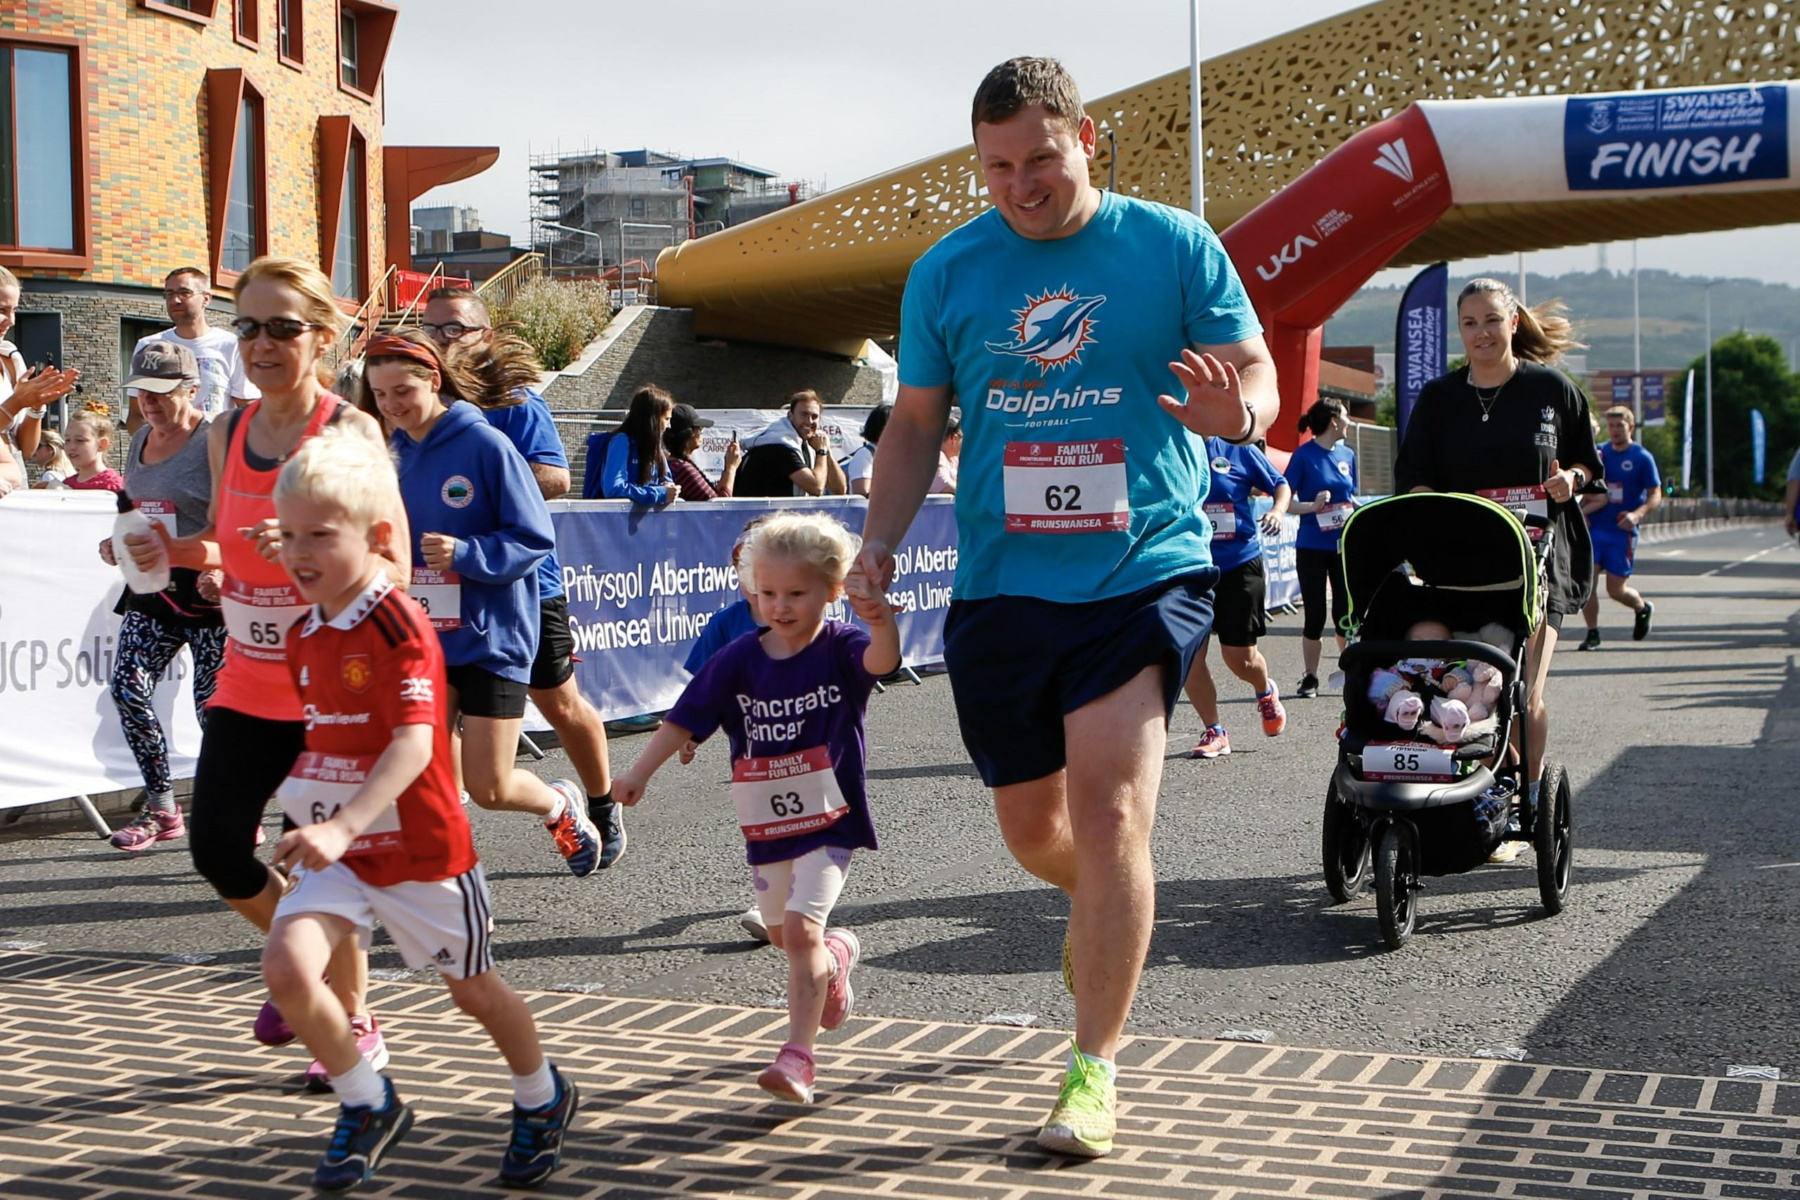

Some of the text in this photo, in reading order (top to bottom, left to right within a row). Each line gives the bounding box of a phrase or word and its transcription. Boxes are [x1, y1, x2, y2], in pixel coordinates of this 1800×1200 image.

[1664, 91, 1764, 110] SWANSEA
[1662, 105, 1765, 122] Half Marathon
[1590, 132, 1763, 180] FINISH
[1316, 208, 1338, 226] UNITED
[1320, 211, 1346, 232] KINGDOM
[1324, 213, 1354, 237] ATHLETICS
[1256, 234, 1319, 281] UKA
[1422, 306, 1435, 362] Marathon
[1408, 307, 1422, 389] SWANSEA
[989, 378, 1047, 390] MIAMI
[985, 385, 1123, 418] Dolphins
[1024, 418, 1070, 428] FOOTBALL
[703, 445, 727, 453] CARRE
[1057, 443, 1099, 456] FAMILY
[1053, 455, 1076, 466] FUN
[1078, 453, 1103, 465] RUN
[1045, 484, 1082, 512] 62
[1507, 487, 1532, 496] FAMILY
[1520, 493, 1535, 501] RUN
[1030, 518, 1102, 529] #RUNSWANSEA
[1211, 520, 1218, 532] 9
[1331, 514, 1344, 525] 56
[914, 545, 958, 574] Aberta
[413, 576, 445, 584] FUN RUN
[414, 569, 441, 577] FAMILY
[253, 586, 291, 597] FAMILY
[563, 561, 740, 610] Prifysgol Abertawe
[252, 595, 272, 606] FUN
[272, 595, 297, 606] RUN
[885, 581, 954, 615] nsea Unive
[249, 621, 280, 645] 65
[568, 602, 725, 654] Swansea Univer
[56, 636, 188, 689] Solirs
[744, 715, 806, 741] Cancer
[323, 756, 360, 770] FAMILY
[768, 754, 804, 770] FAMILY
[768, 767, 789, 779] FUN
[789, 762, 812, 776] RUN
[1394, 753, 1420, 772] 85
[317, 768, 338, 781] FUN
[339, 769, 366, 782] RUN
[1382, 774, 1434, 782] #RUNSWANSEA
[770, 791, 805, 818] 63
[764, 816, 828, 837] #RUNSWANSEA
